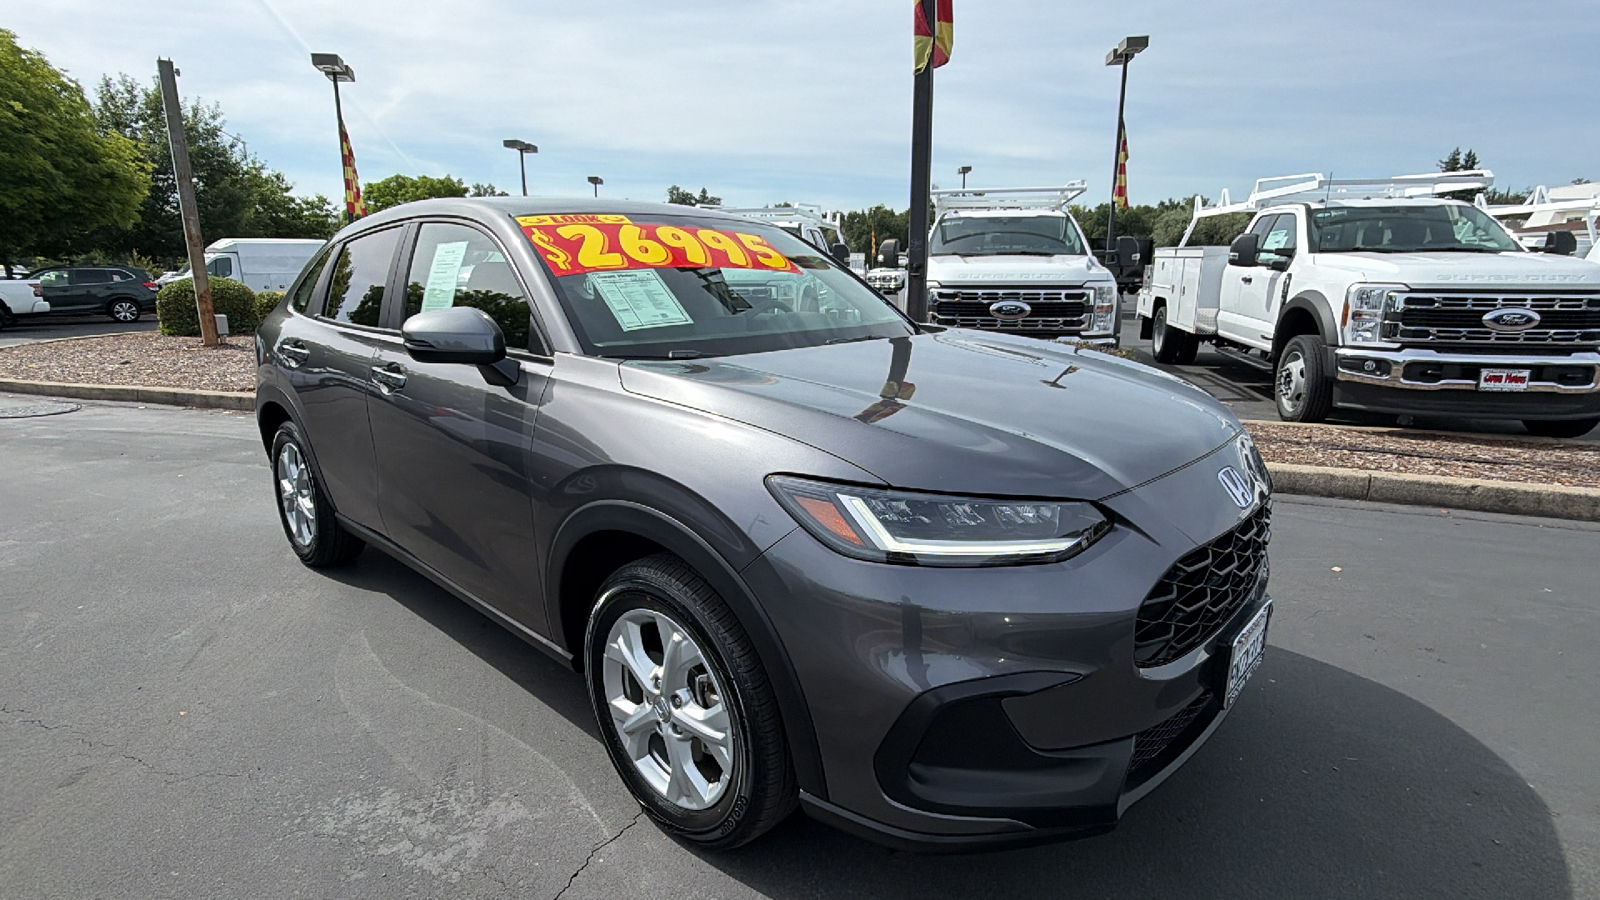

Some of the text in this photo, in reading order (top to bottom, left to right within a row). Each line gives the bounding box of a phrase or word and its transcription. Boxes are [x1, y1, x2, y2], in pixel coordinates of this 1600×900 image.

[549, 215, 600, 223] LOOK
[1436, 274, 1587, 282] SUPER DUTY
[1499, 314, 1529, 326] Ford
